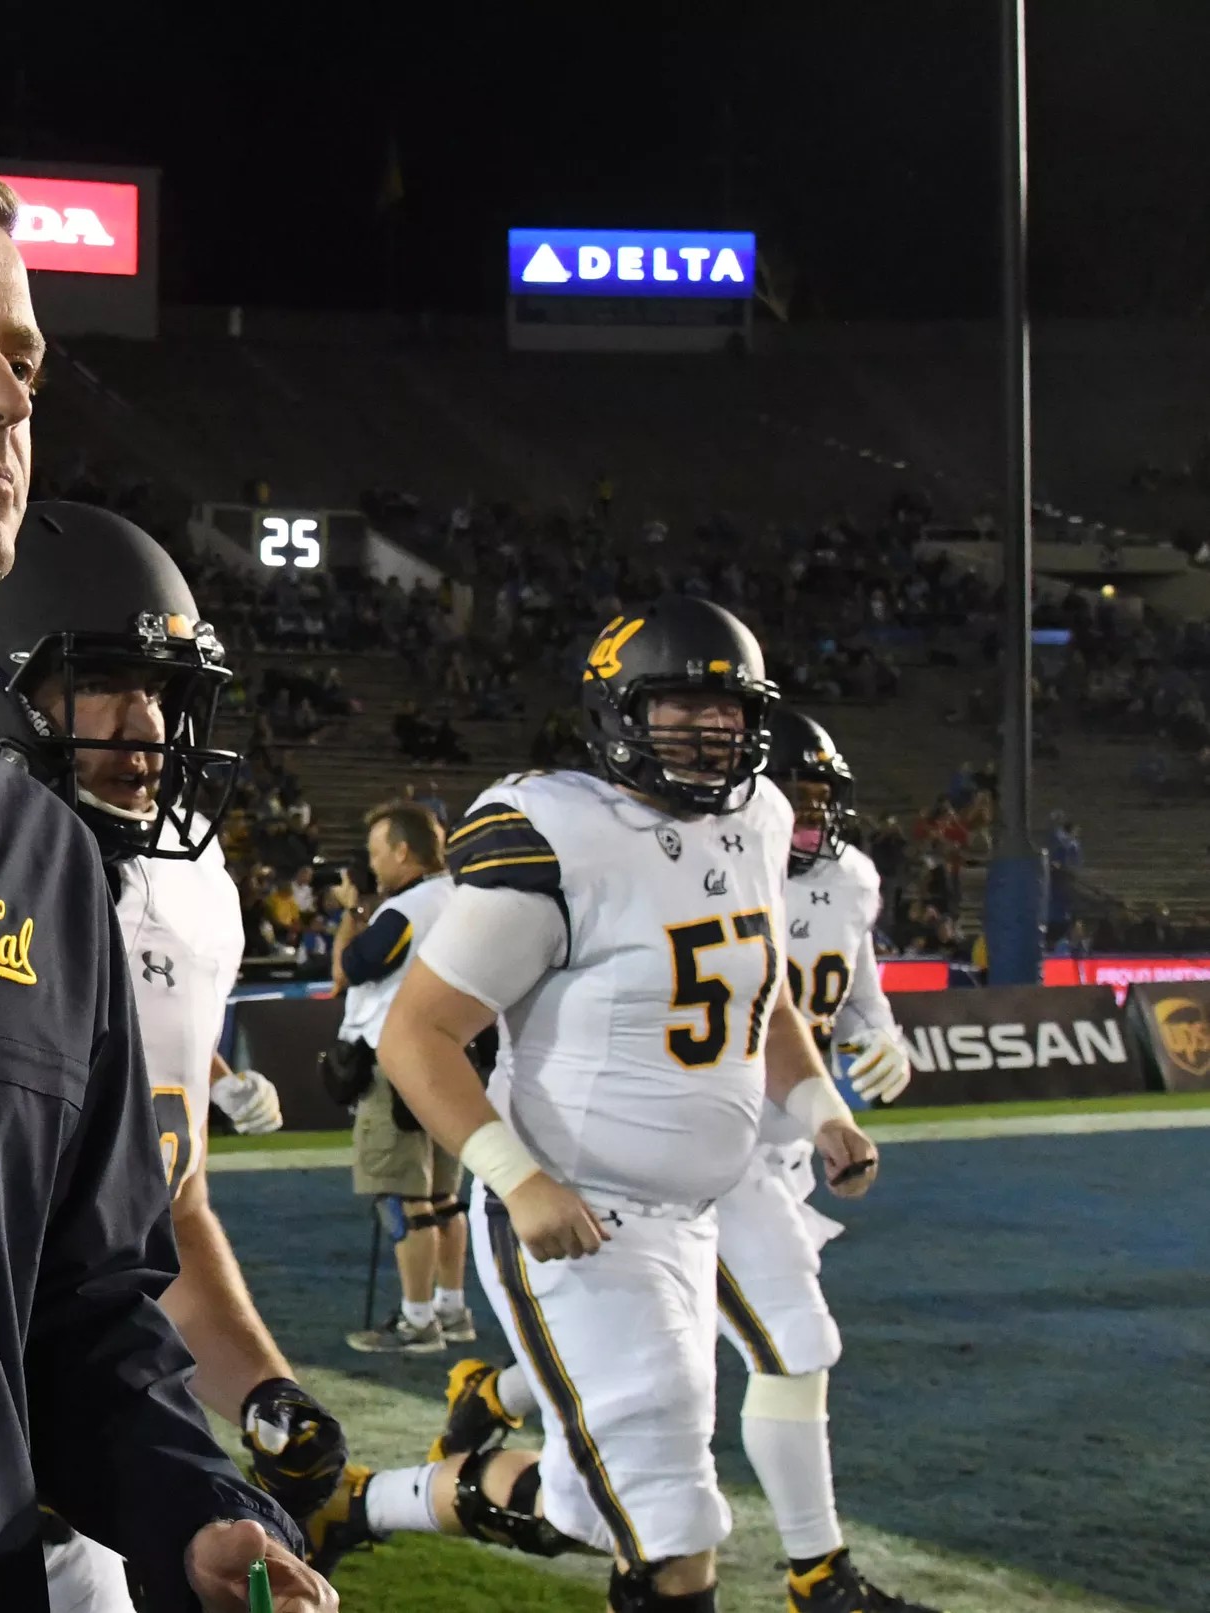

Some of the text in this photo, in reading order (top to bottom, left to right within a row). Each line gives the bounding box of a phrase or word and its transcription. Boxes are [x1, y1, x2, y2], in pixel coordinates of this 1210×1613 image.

[11, 205, 114, 246] DA
[578, 245, 745, 282] DELTA
[260, 518, 320, 568] 25
[663, 906, 777, 1071] 57
[906, 1019, 1127, 1072] NISSAN
